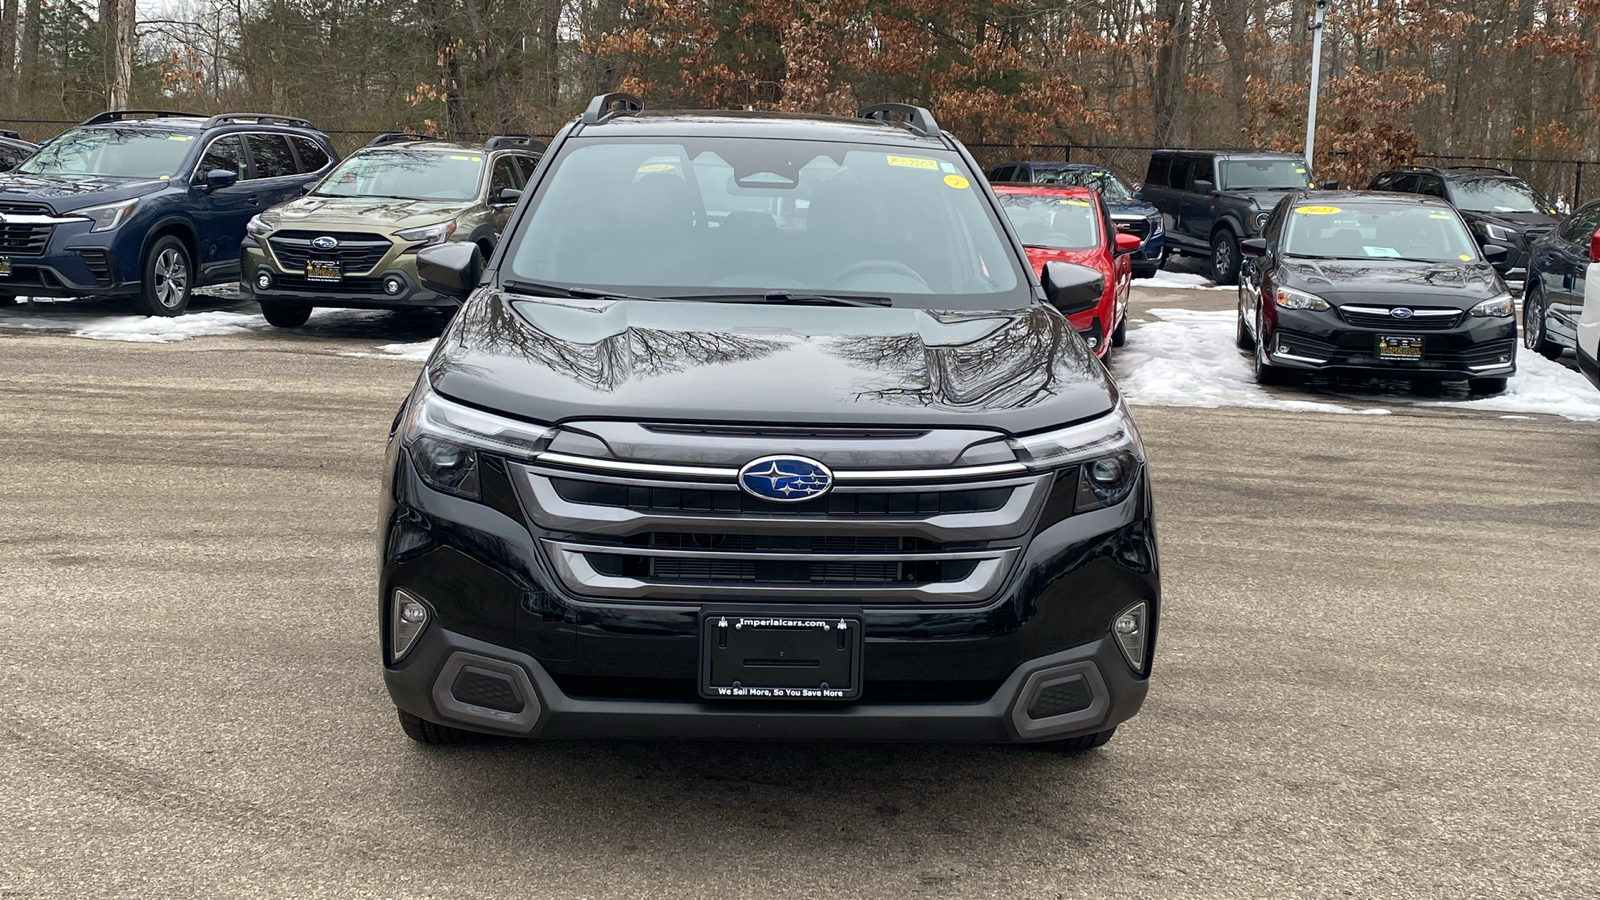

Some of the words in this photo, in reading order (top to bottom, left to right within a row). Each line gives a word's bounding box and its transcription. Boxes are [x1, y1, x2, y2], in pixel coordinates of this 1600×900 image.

[740, 618, 826, 627] Imperialcars.com
[749, 689, 772, 697] More,
[802, 689, 822, 697] Save
